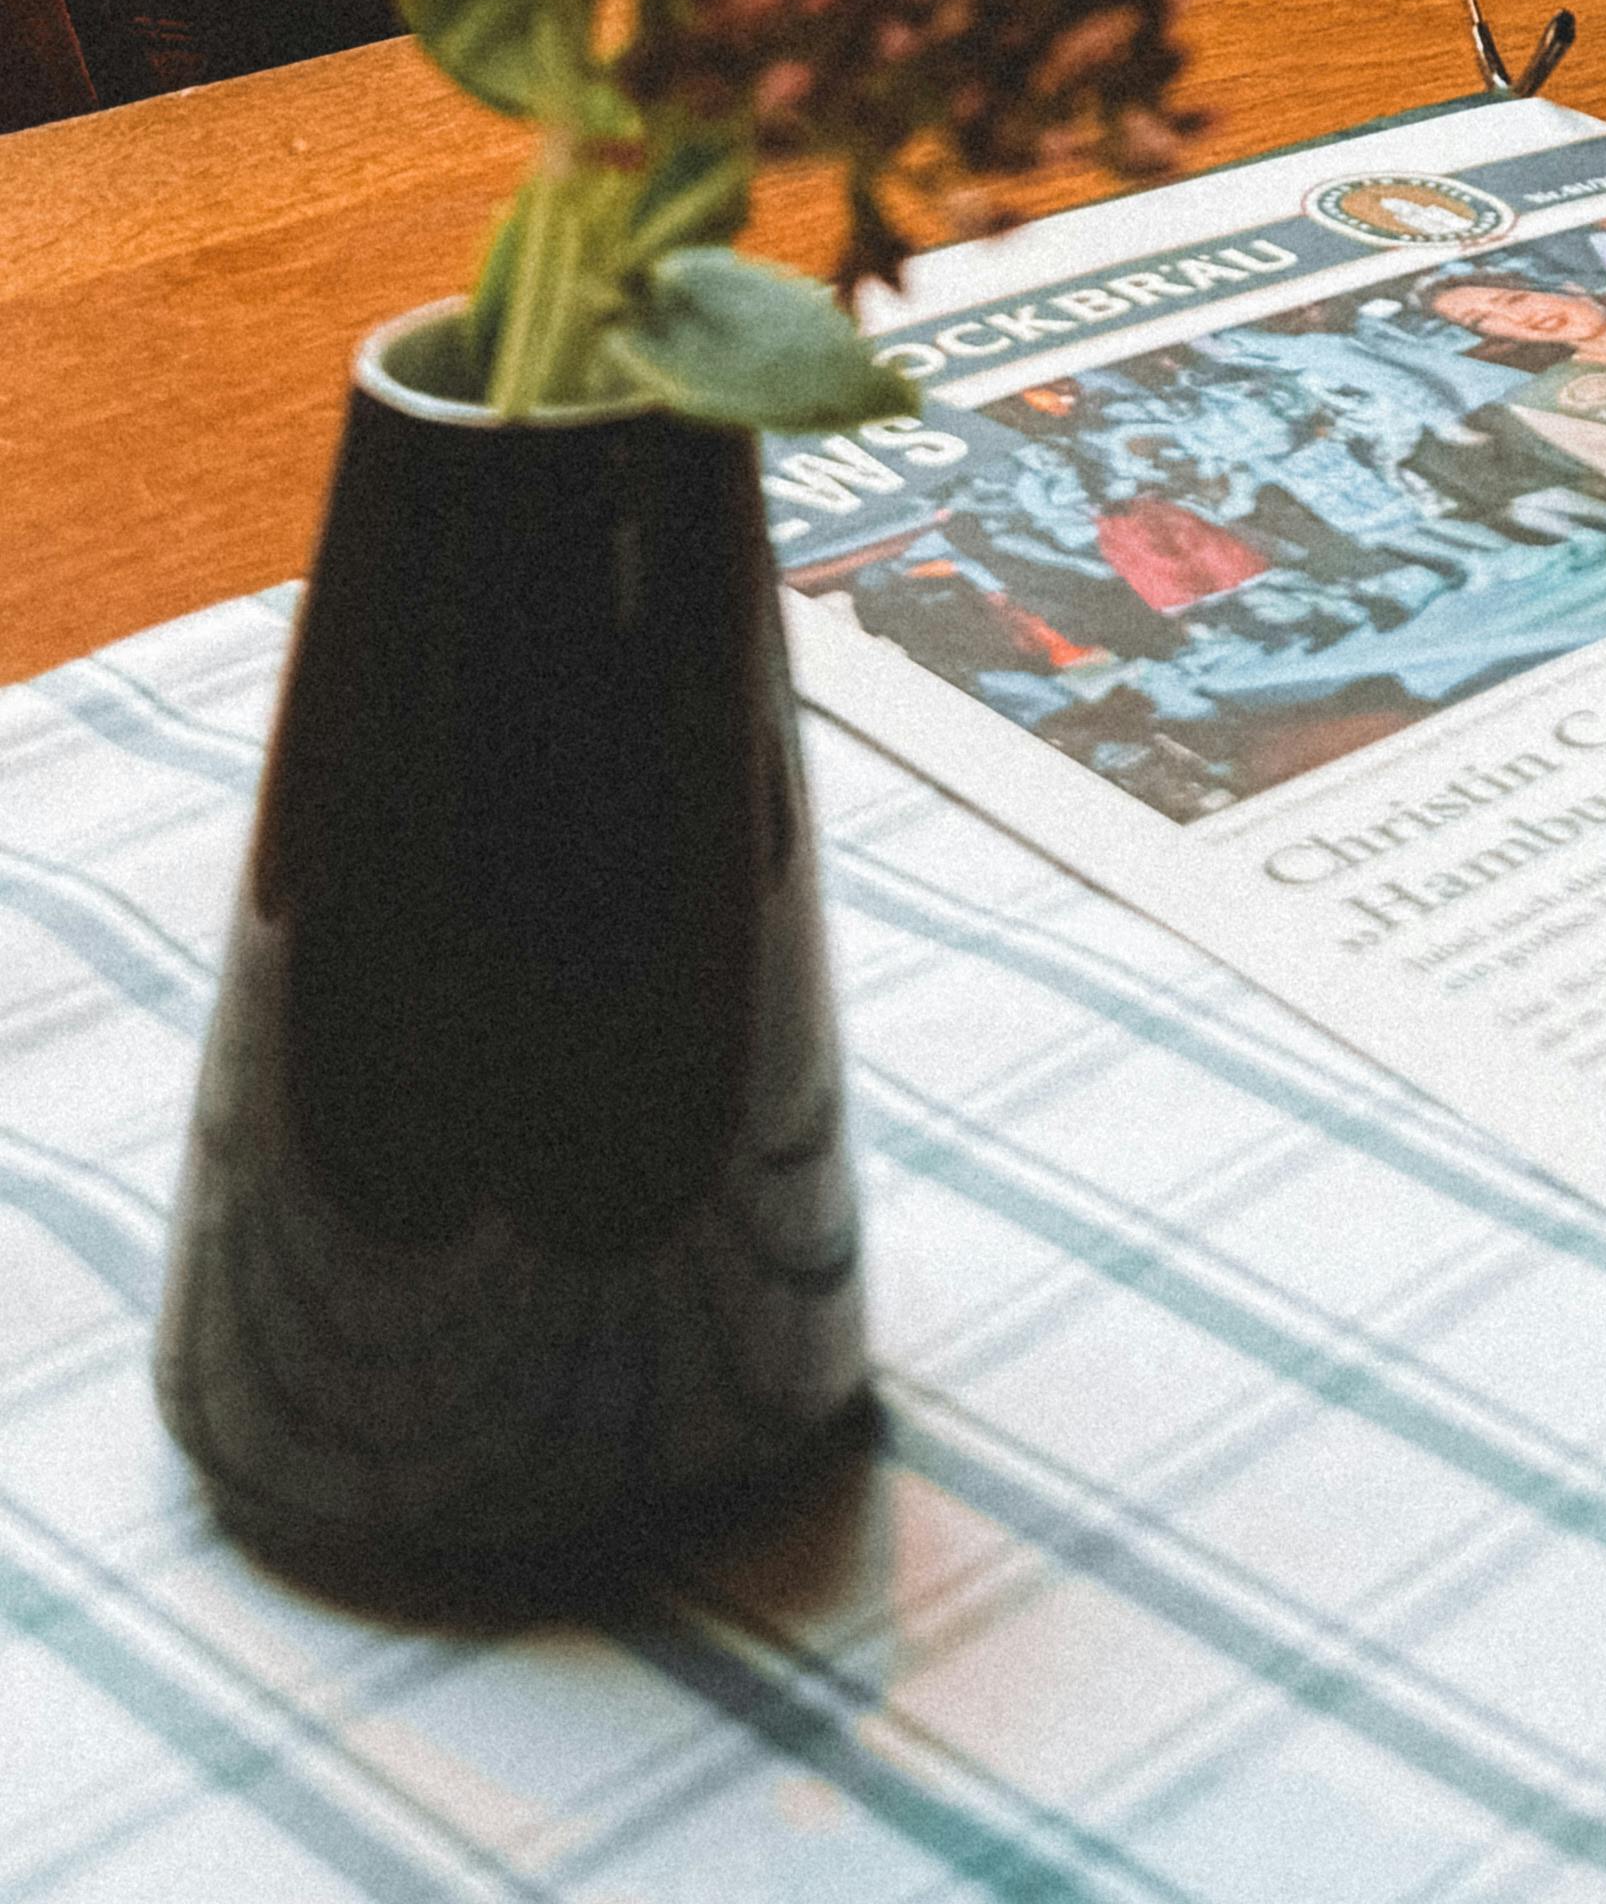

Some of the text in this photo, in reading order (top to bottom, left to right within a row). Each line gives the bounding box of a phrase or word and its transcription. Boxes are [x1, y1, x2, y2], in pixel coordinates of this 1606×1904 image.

[871, 238, 1299, 380] OCKBRÄU
[760, 414, 969, 541] WS
[1263, 750, 1564, 886] Christin
